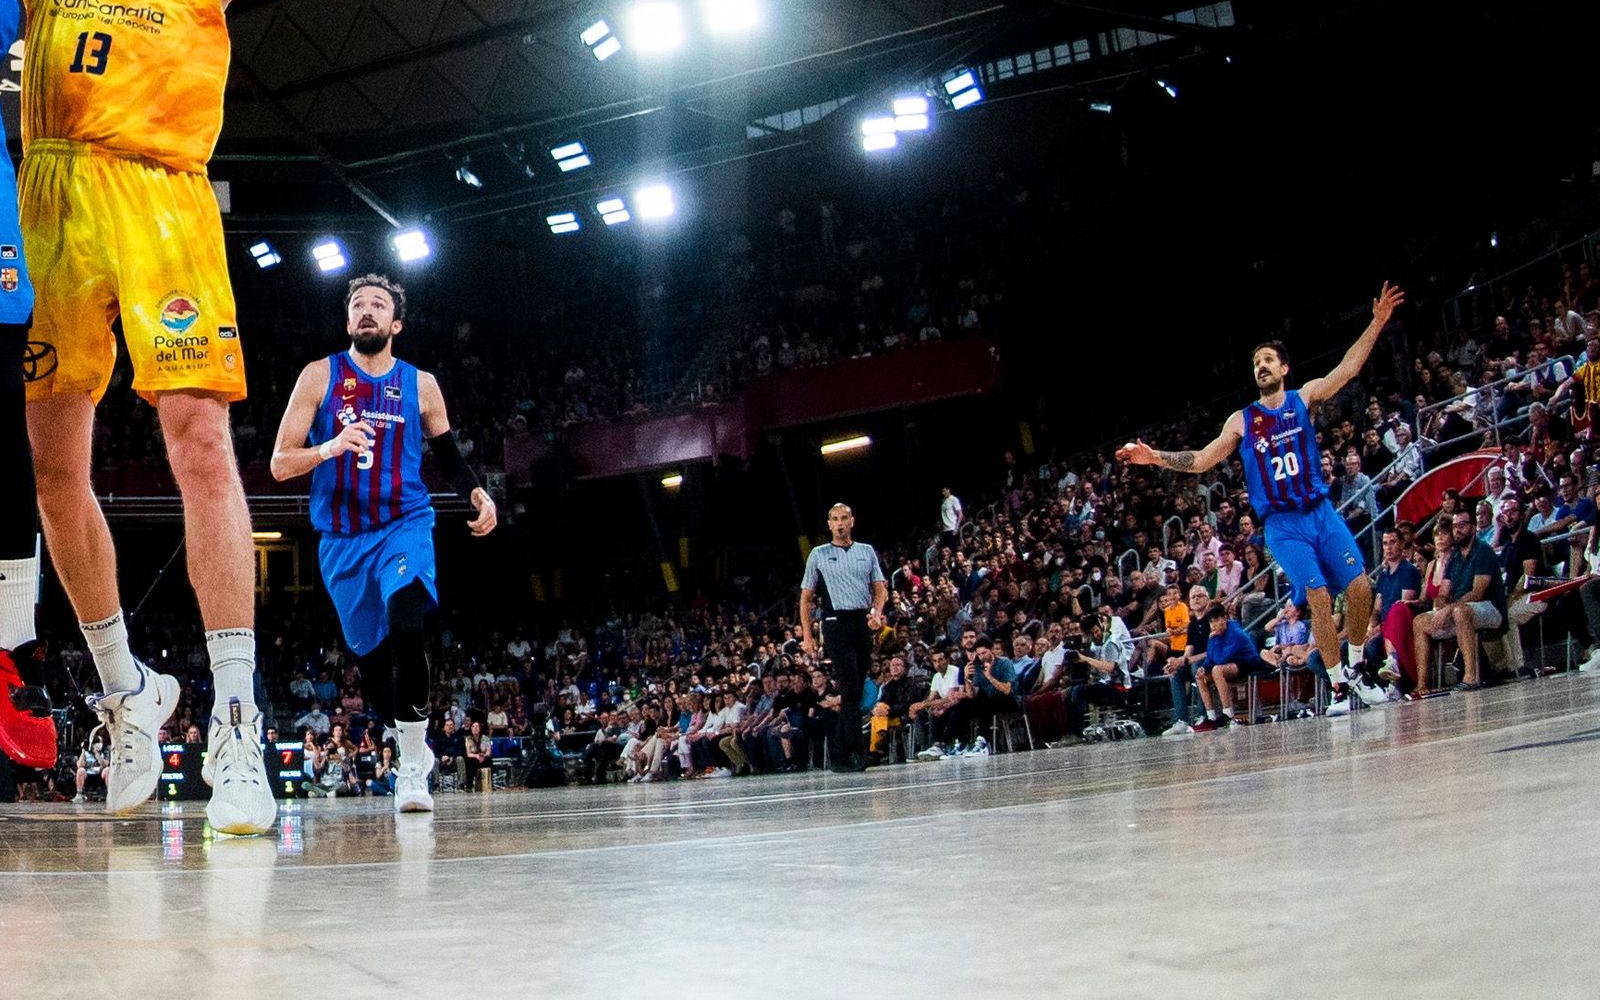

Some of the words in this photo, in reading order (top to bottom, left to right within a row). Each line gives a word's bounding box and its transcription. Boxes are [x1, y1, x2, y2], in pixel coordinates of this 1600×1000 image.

[69, 31, 112, 76] 13
[154, 335, 208, 349] Poema
[156, 350, 177, 362] del
[182, 349, 209, 361] Mar
[1271, 452, 1299, 480] 20
[169, 753, 180, 766] 4
[282, 751, 292, 765] 7
